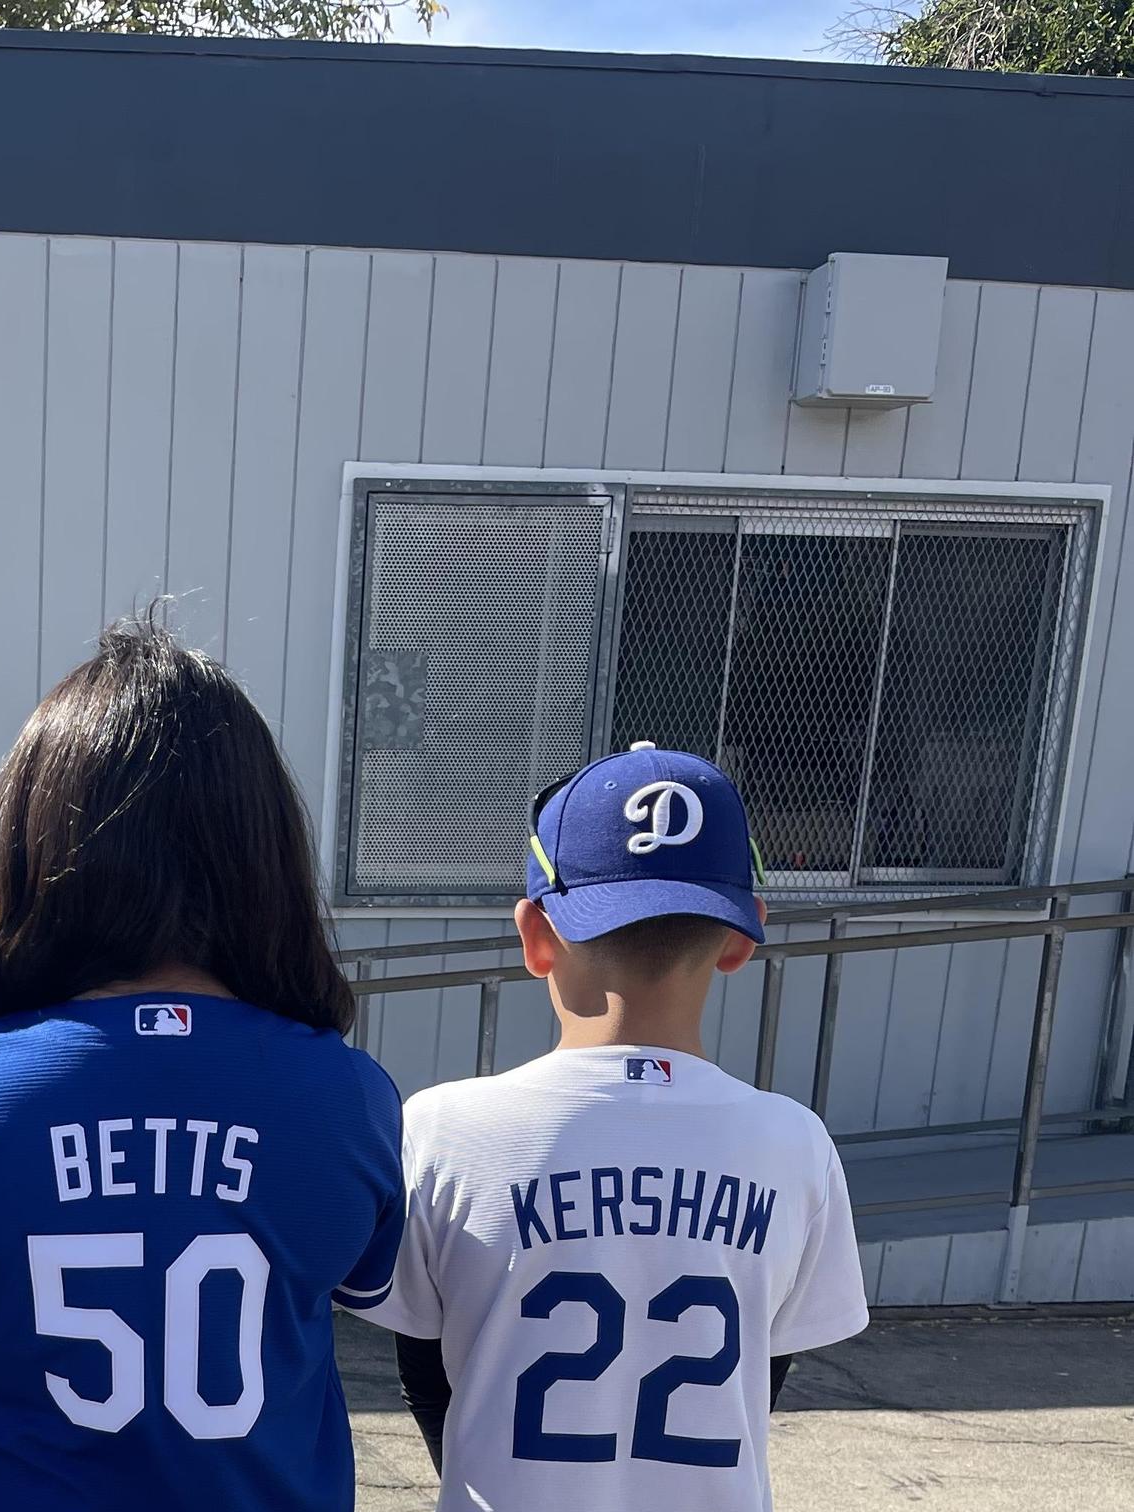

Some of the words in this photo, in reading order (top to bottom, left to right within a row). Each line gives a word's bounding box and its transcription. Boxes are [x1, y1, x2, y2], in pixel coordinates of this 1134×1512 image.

[624, 781, 704, 854] D
[50, 1118, 259, 1202] BETTS
[510, 1166, 777, 1255] KERSHAW
[27, 1233, 271, 1440] 50
[512, 1271, 742, 1468] 22
